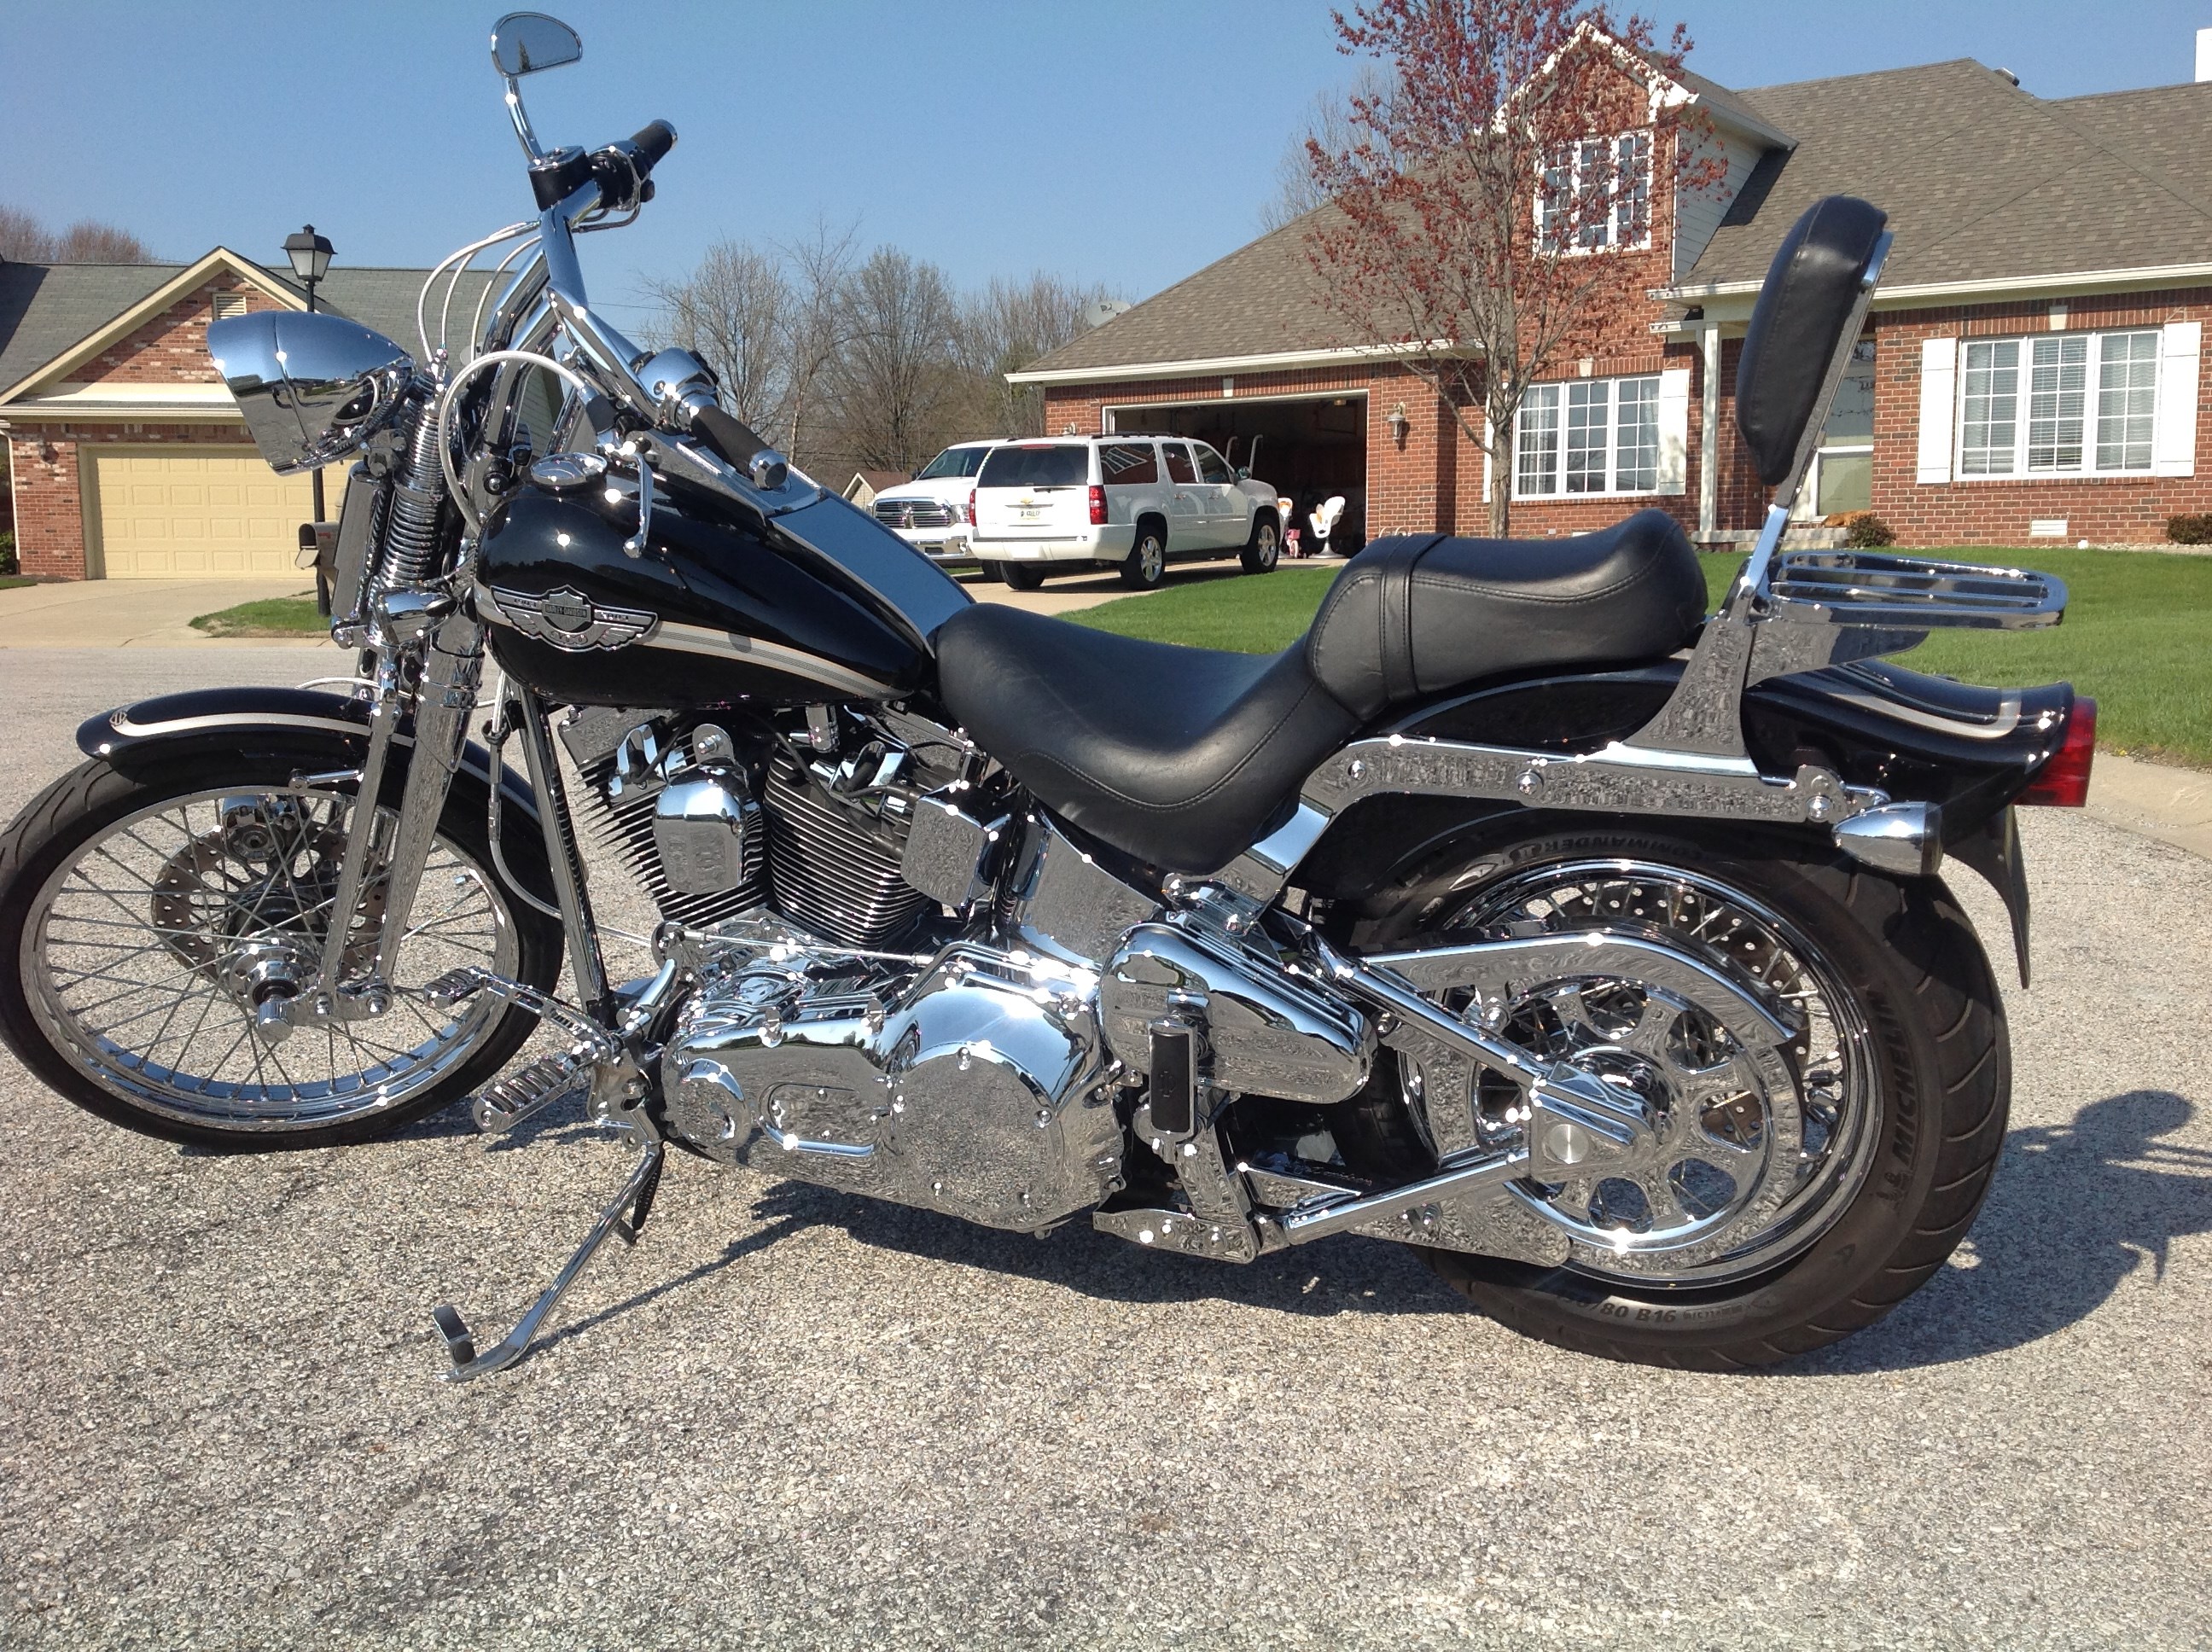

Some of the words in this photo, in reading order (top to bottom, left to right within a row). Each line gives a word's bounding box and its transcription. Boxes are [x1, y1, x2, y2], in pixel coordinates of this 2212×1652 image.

[1545, 837, 1703, 860] COMMANDER
[1866, 990, 1917, 1166] MICHELIN
[1635, 1308, 1676, 1323] B16
